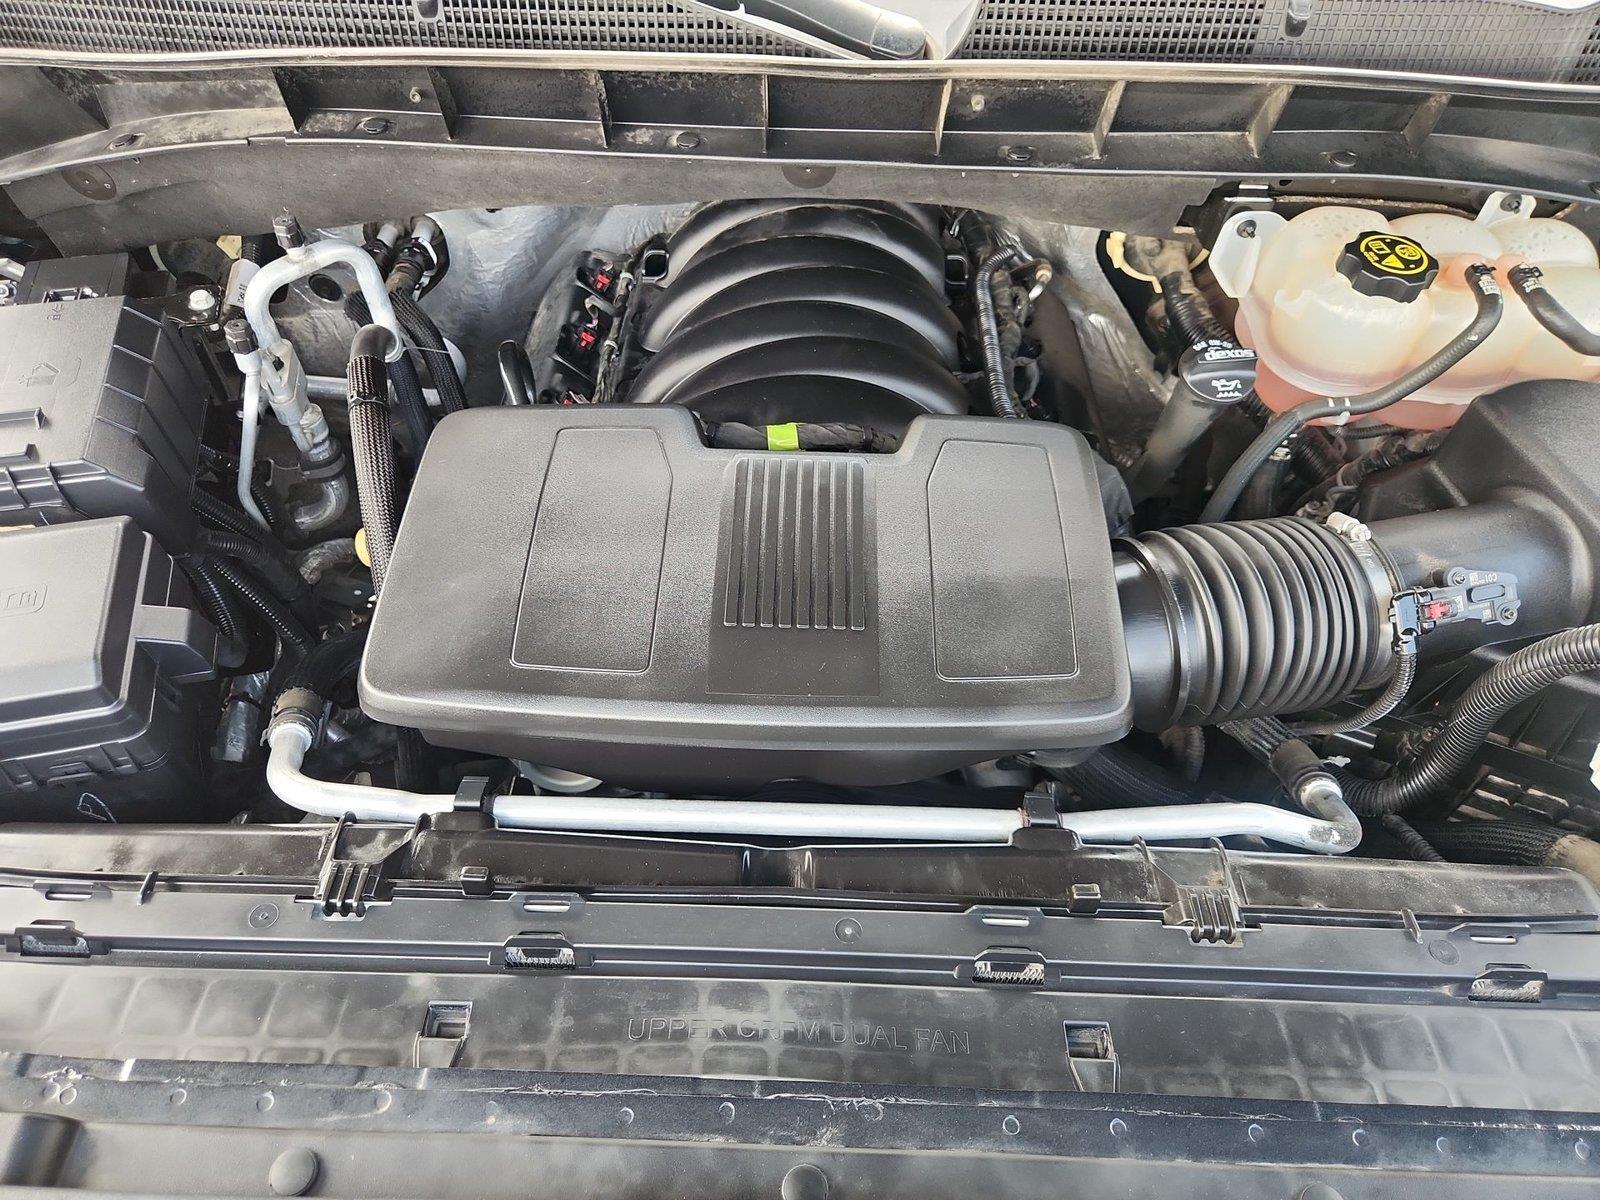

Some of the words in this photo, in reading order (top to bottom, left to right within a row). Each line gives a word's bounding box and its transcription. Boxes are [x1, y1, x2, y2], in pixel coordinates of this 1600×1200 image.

[1204, 349, 1255, 360] dexos
[627, 1017, 728, 1041] UPPER
[829, 1020, 908, 1051] DUAL
[914, 1026, 971, 1055] FAN
